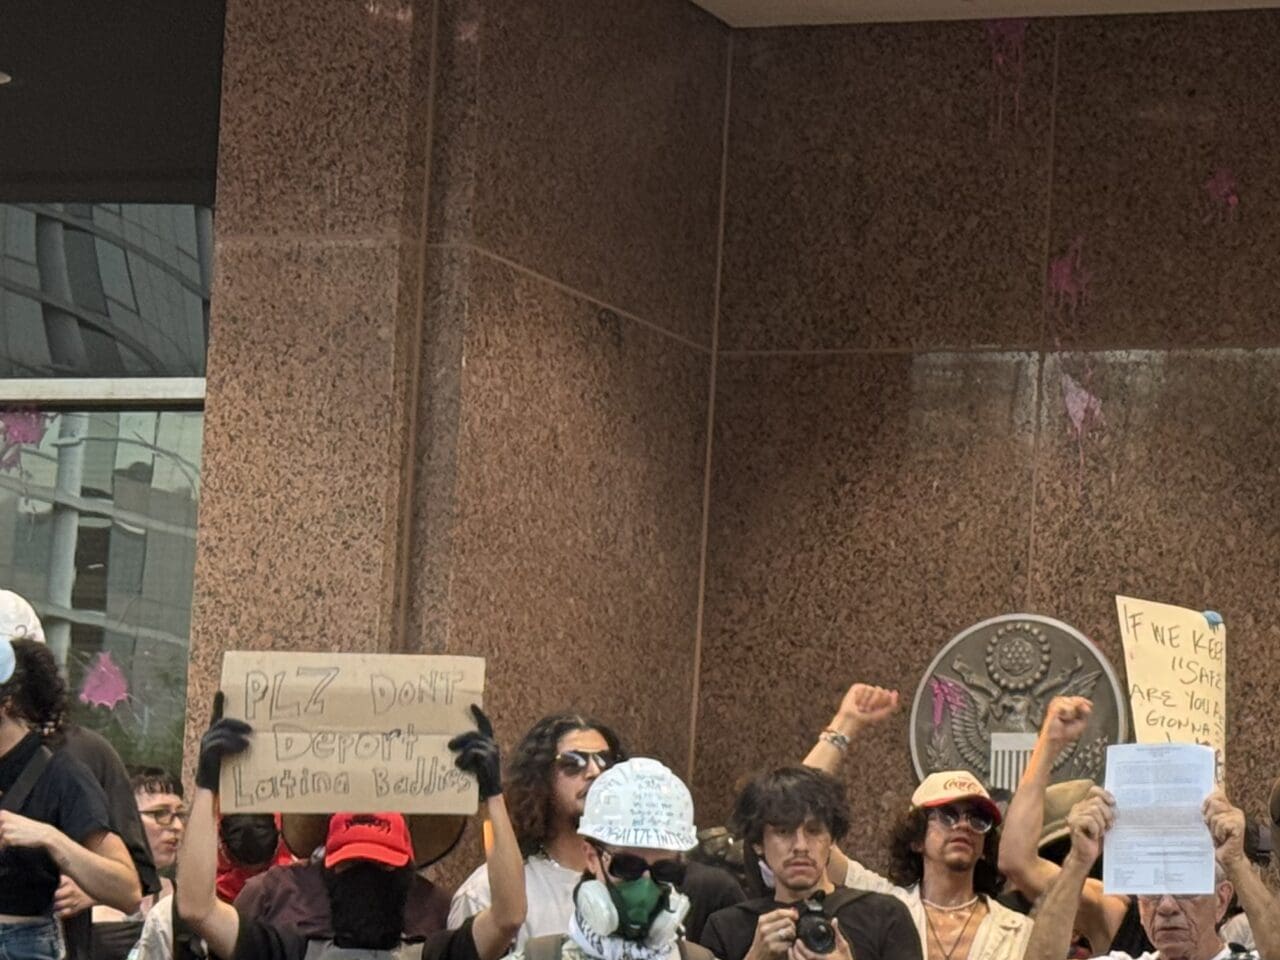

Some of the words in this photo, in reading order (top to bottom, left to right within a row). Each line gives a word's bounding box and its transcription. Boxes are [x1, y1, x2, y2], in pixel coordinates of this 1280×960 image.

[1122, 603, 1145, 642] IF
[1151, 621, 1181, 649] WE
[244, 666, 341, 721] PLZ
[1130, 683, 1176, 709] ARE
[272, 722, 419, 764] Deport
[232, 764, 350, 809] Latina
